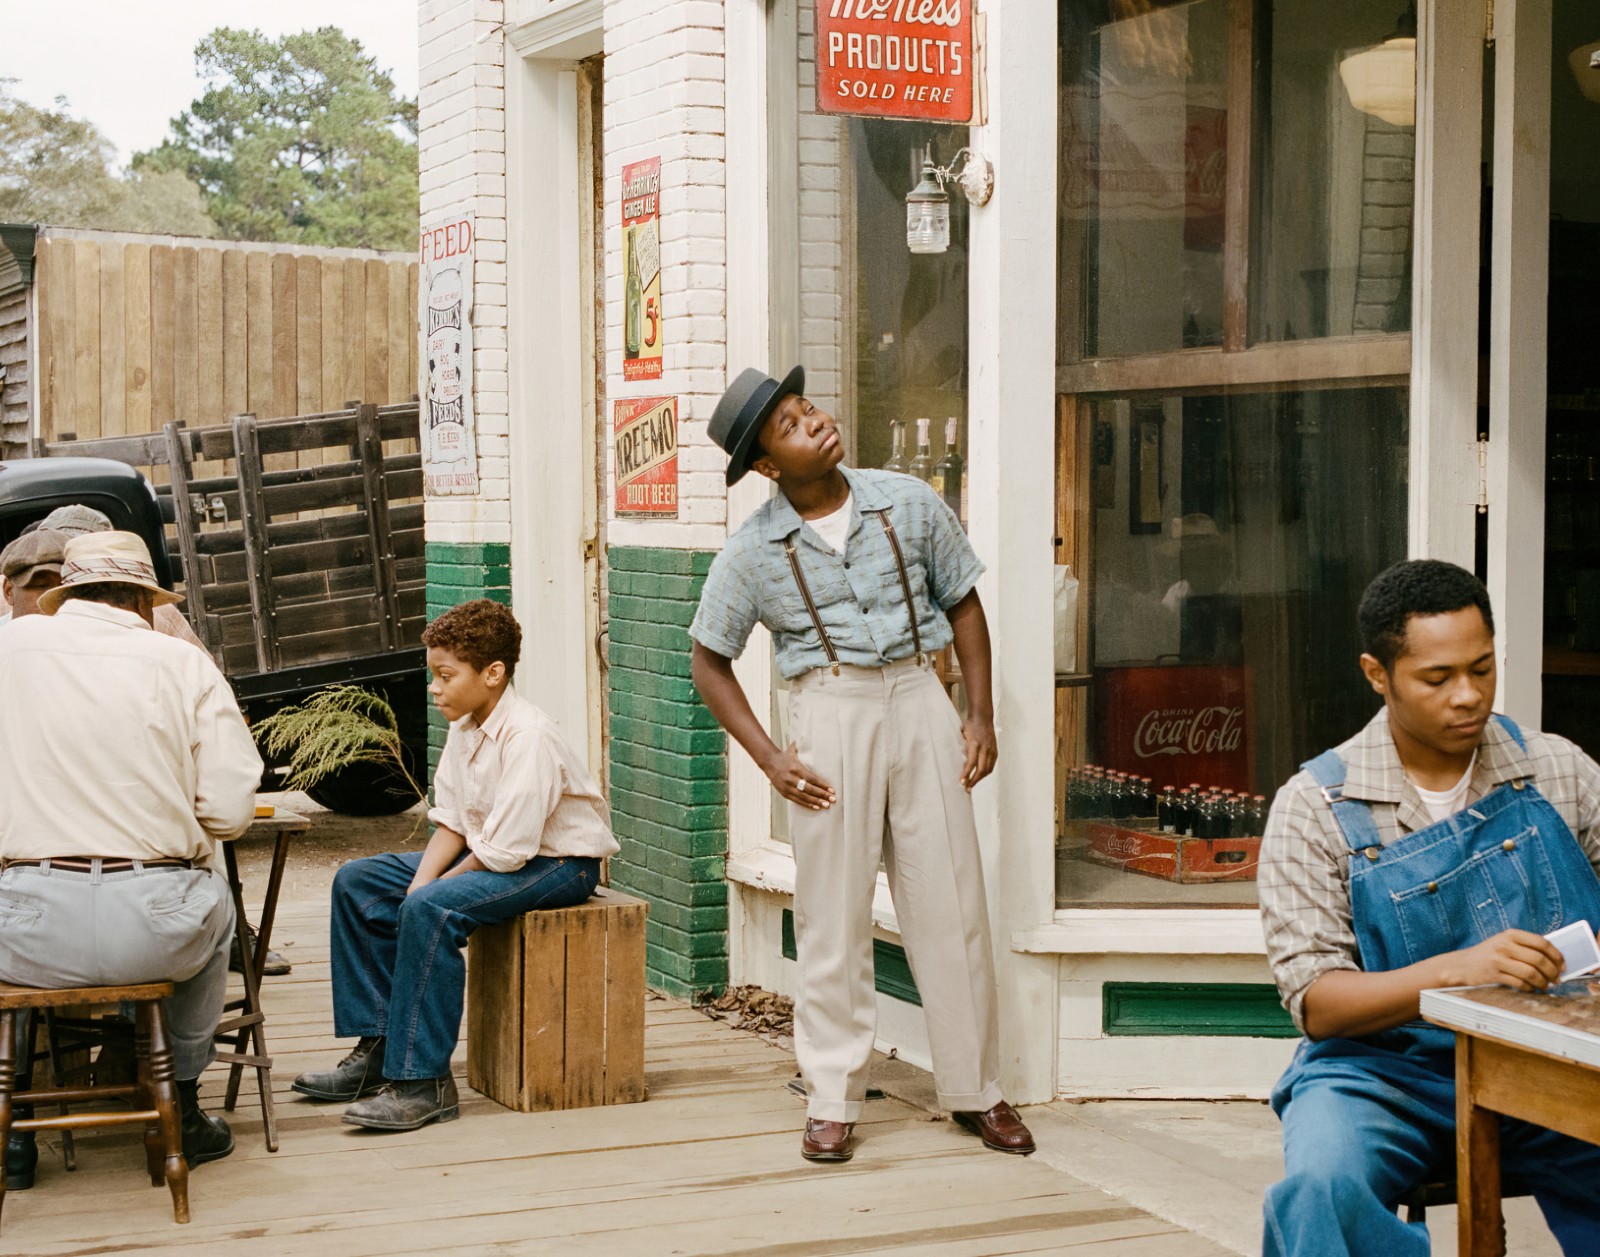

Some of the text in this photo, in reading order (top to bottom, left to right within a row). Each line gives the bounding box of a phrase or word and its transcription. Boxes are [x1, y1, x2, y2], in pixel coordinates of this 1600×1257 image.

[828, 31, 962, 76] PRODUCTS
[837, 79, 955, 104] SOLD HERE
[644, 194, 656, 215] ALE
[421, 219, 472, 265] FEED
[431, 400, 461, 426] FEEDS
[616, 405, 634, 426] DRINK
[435, 474, 453, 487] BETTER
[455, 472, 476, 487] RESULTS
[627, 483, 677, 505] ROOT BEER
[1161, 708, 1195, 717] DRINK
[1133, 706, 1245, 758] Coca-Cola
